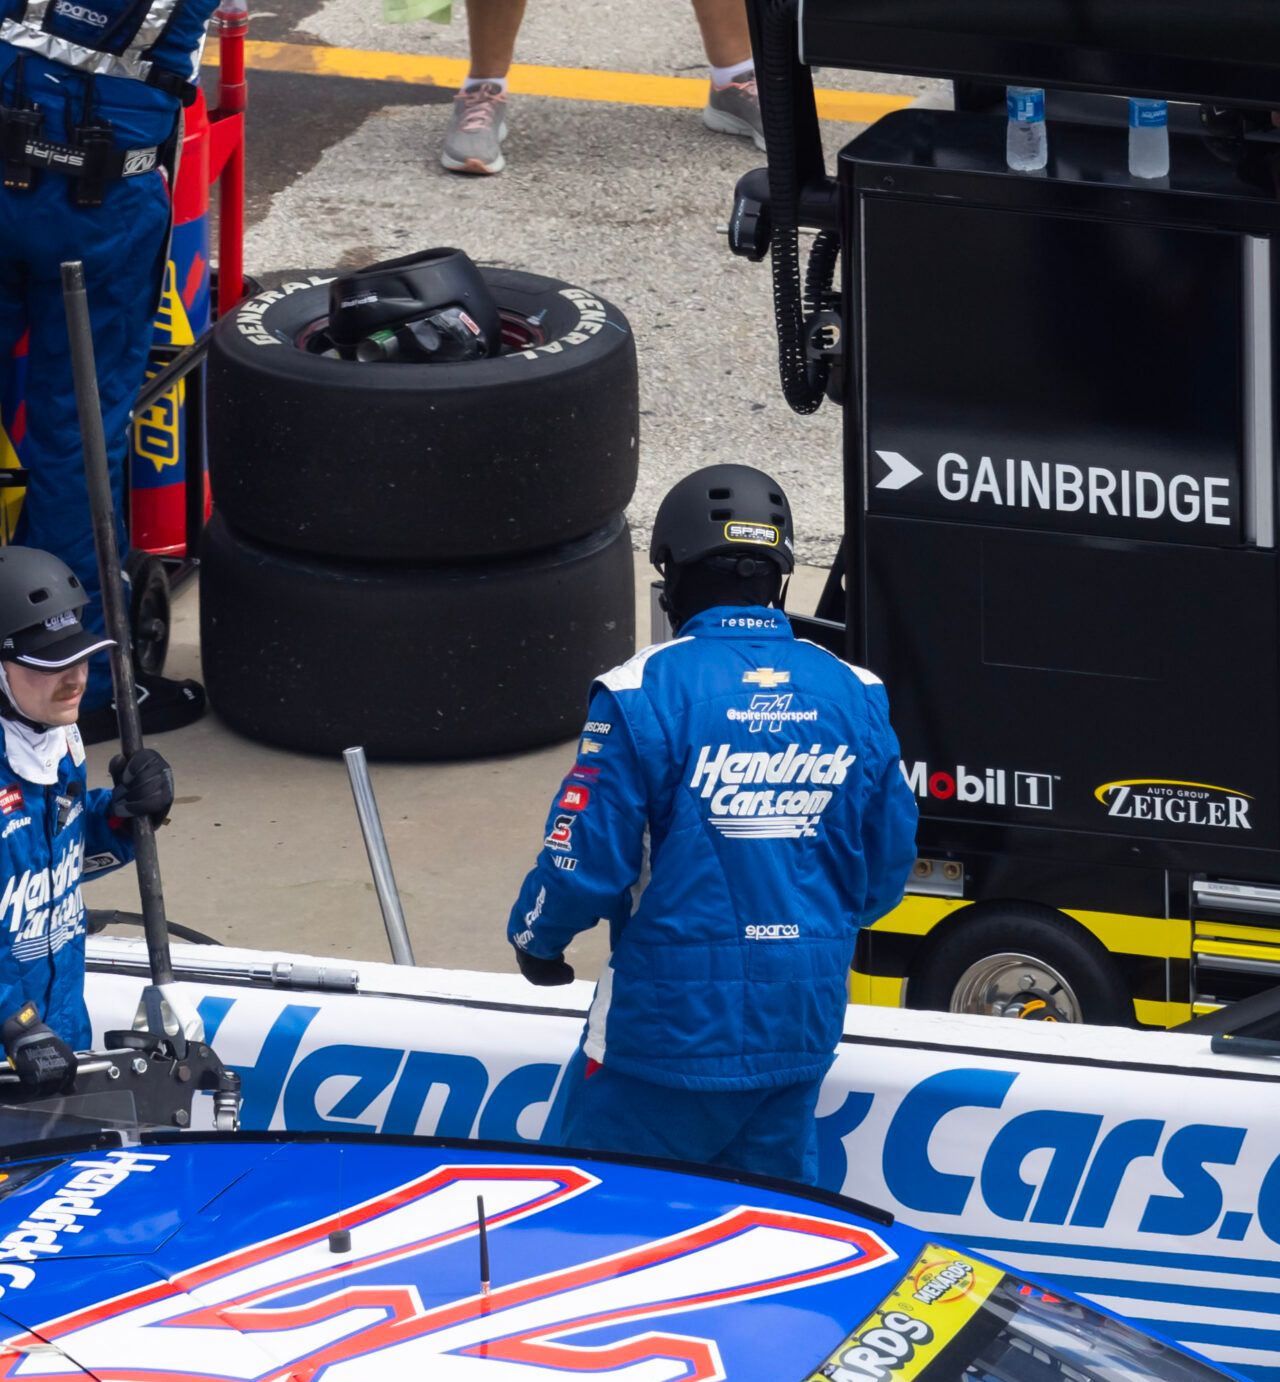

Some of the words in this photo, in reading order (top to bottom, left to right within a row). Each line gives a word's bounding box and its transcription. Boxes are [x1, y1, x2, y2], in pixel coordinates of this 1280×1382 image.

[236, 276, 339, 346] GENERAL
[507, 288, 607, 360] GENERAL
[936, 452, 1232, 526] GAINBRIDGE
[721, 617, 779, 630] respect.
[726, 708, 819, 723] @spiremotorsport
[689, 743, 857, 799] Hendrick
[899, 761, 1007, 807] Mobil
[1147, 787, 1174, 797] AUTO
[1177, 789, 1210, 799] GROUP
[708, 788, 834, 816] Cars.com
[1107, 784, 1253, 831] ZEIGLER
[744, 922, 801, 940] sparco
[912, 1259, 975, 1305] MENARDS
